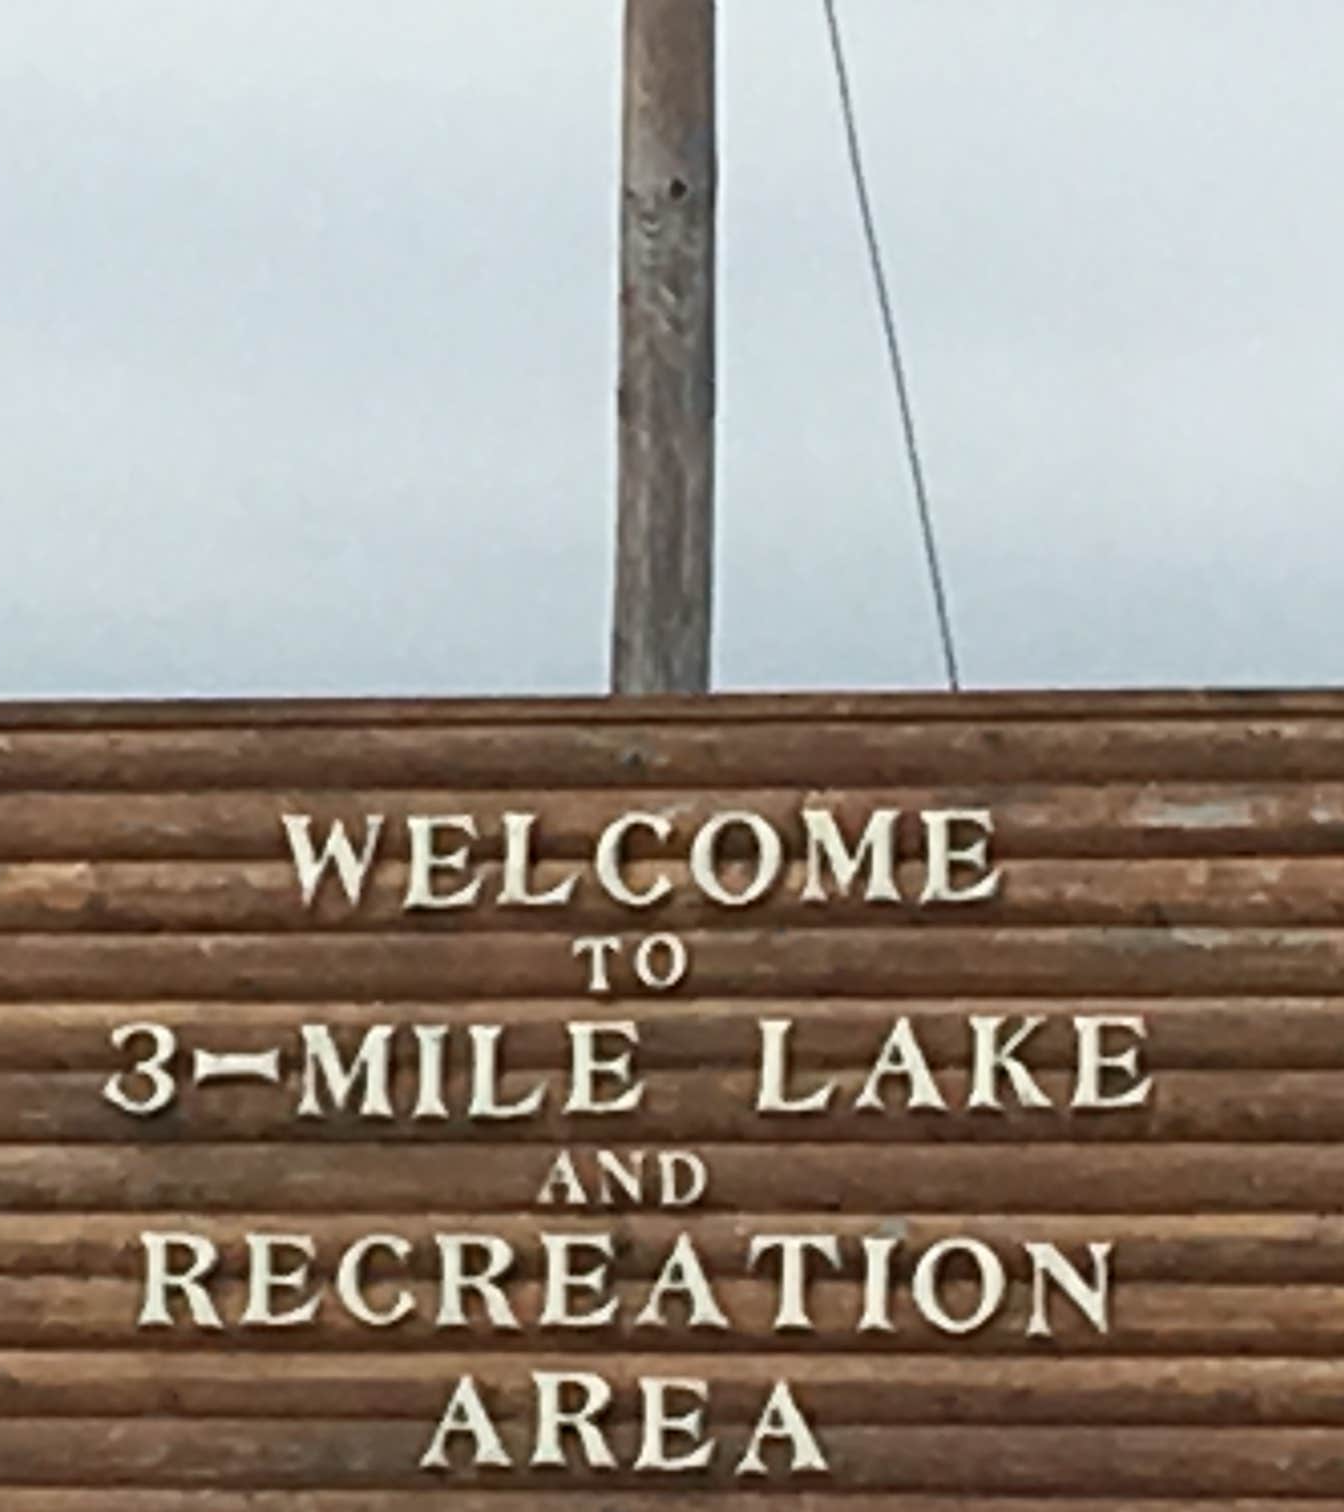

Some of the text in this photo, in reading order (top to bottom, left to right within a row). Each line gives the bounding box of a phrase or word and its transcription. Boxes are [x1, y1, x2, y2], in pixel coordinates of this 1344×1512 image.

[282, 807, 1005, 911] WELCOME
[572, 933, 690, 992] TO
[101, 1013, 1157, 1121] 3-MILE LAKE
[537, 1150, 708, 1207] AND
[137, 1231, 1114, 1339] RECREATION
[419, 1371, 830, 1477] AREA
